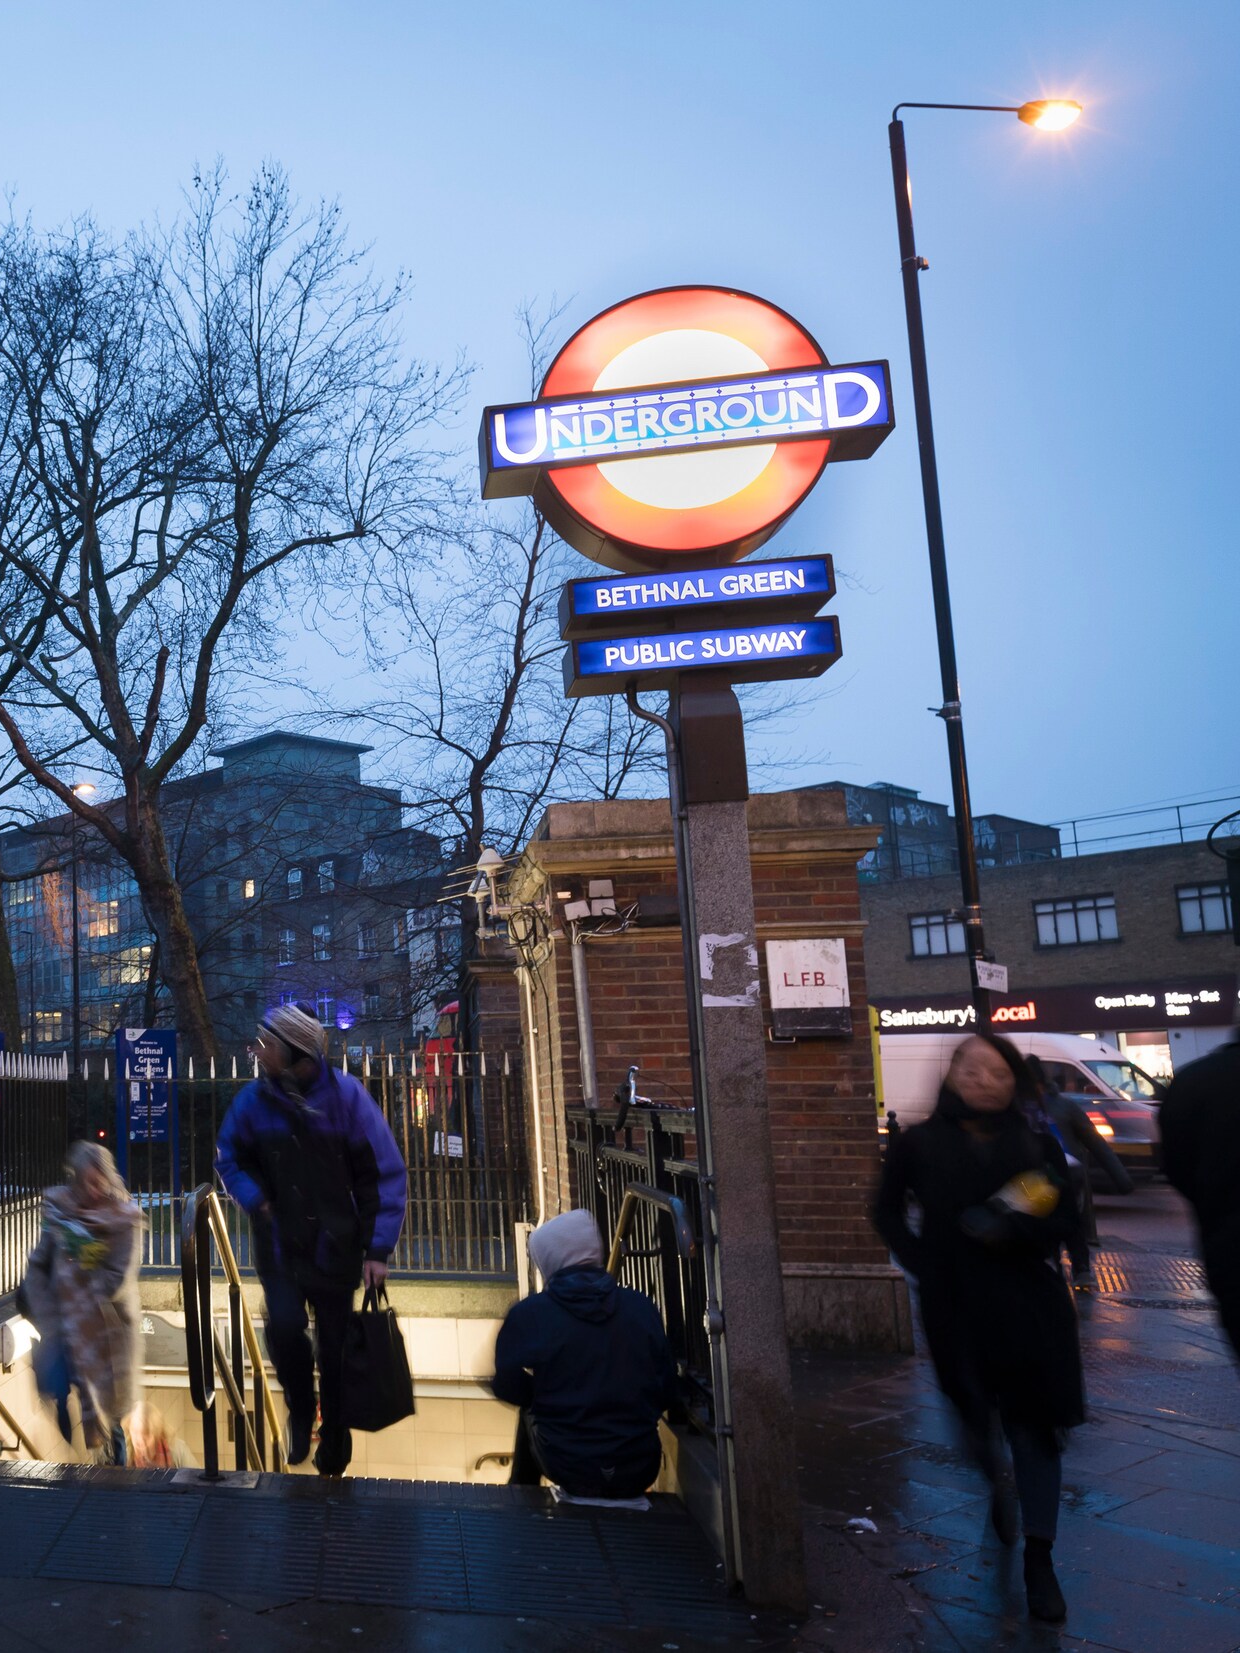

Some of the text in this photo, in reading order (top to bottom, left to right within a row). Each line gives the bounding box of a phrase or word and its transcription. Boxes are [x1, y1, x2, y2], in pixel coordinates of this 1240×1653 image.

[494, 371, 881, 465] UNDERGROUND
[595, 568, 806, 608] BETHNAL GREEN
[604, 629, 807, 668] PUBLIC SUBWAY
[880, 1004, 977, 1028] Sainsbury's
[134, 1046, 163, 1055] Bethnal
[134, 1065, 164, 1073] Garens
